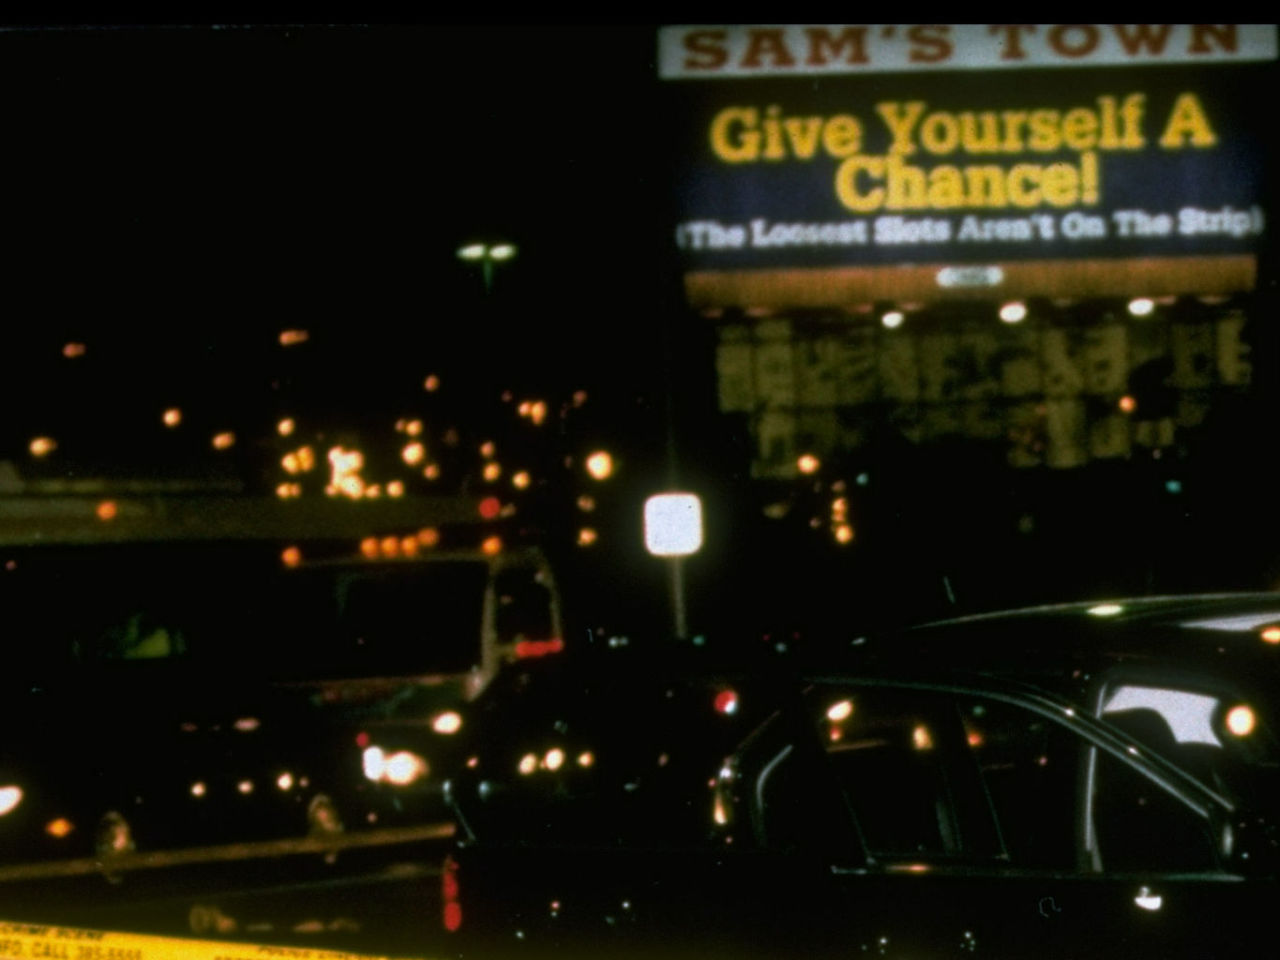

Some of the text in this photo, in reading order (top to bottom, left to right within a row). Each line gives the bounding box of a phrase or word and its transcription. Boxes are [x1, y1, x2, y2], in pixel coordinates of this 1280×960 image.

[683, 24, 1240, 72] SAM'S TOWN
[710, 92, 1216, 164] Give Yourself A
[835, 151, 1098, 212] Chance!
[676, 220, 745, 249] (The
[873, 213, 950, 246] Slots
[957, 214, 1055, 243] Aren't
[1060, 210, 1106, 239] On
[1113, 208, 1173, 238] The
[1177, 205, 1264, 239] Strip)
[31, 941, 68, 960] CALL
